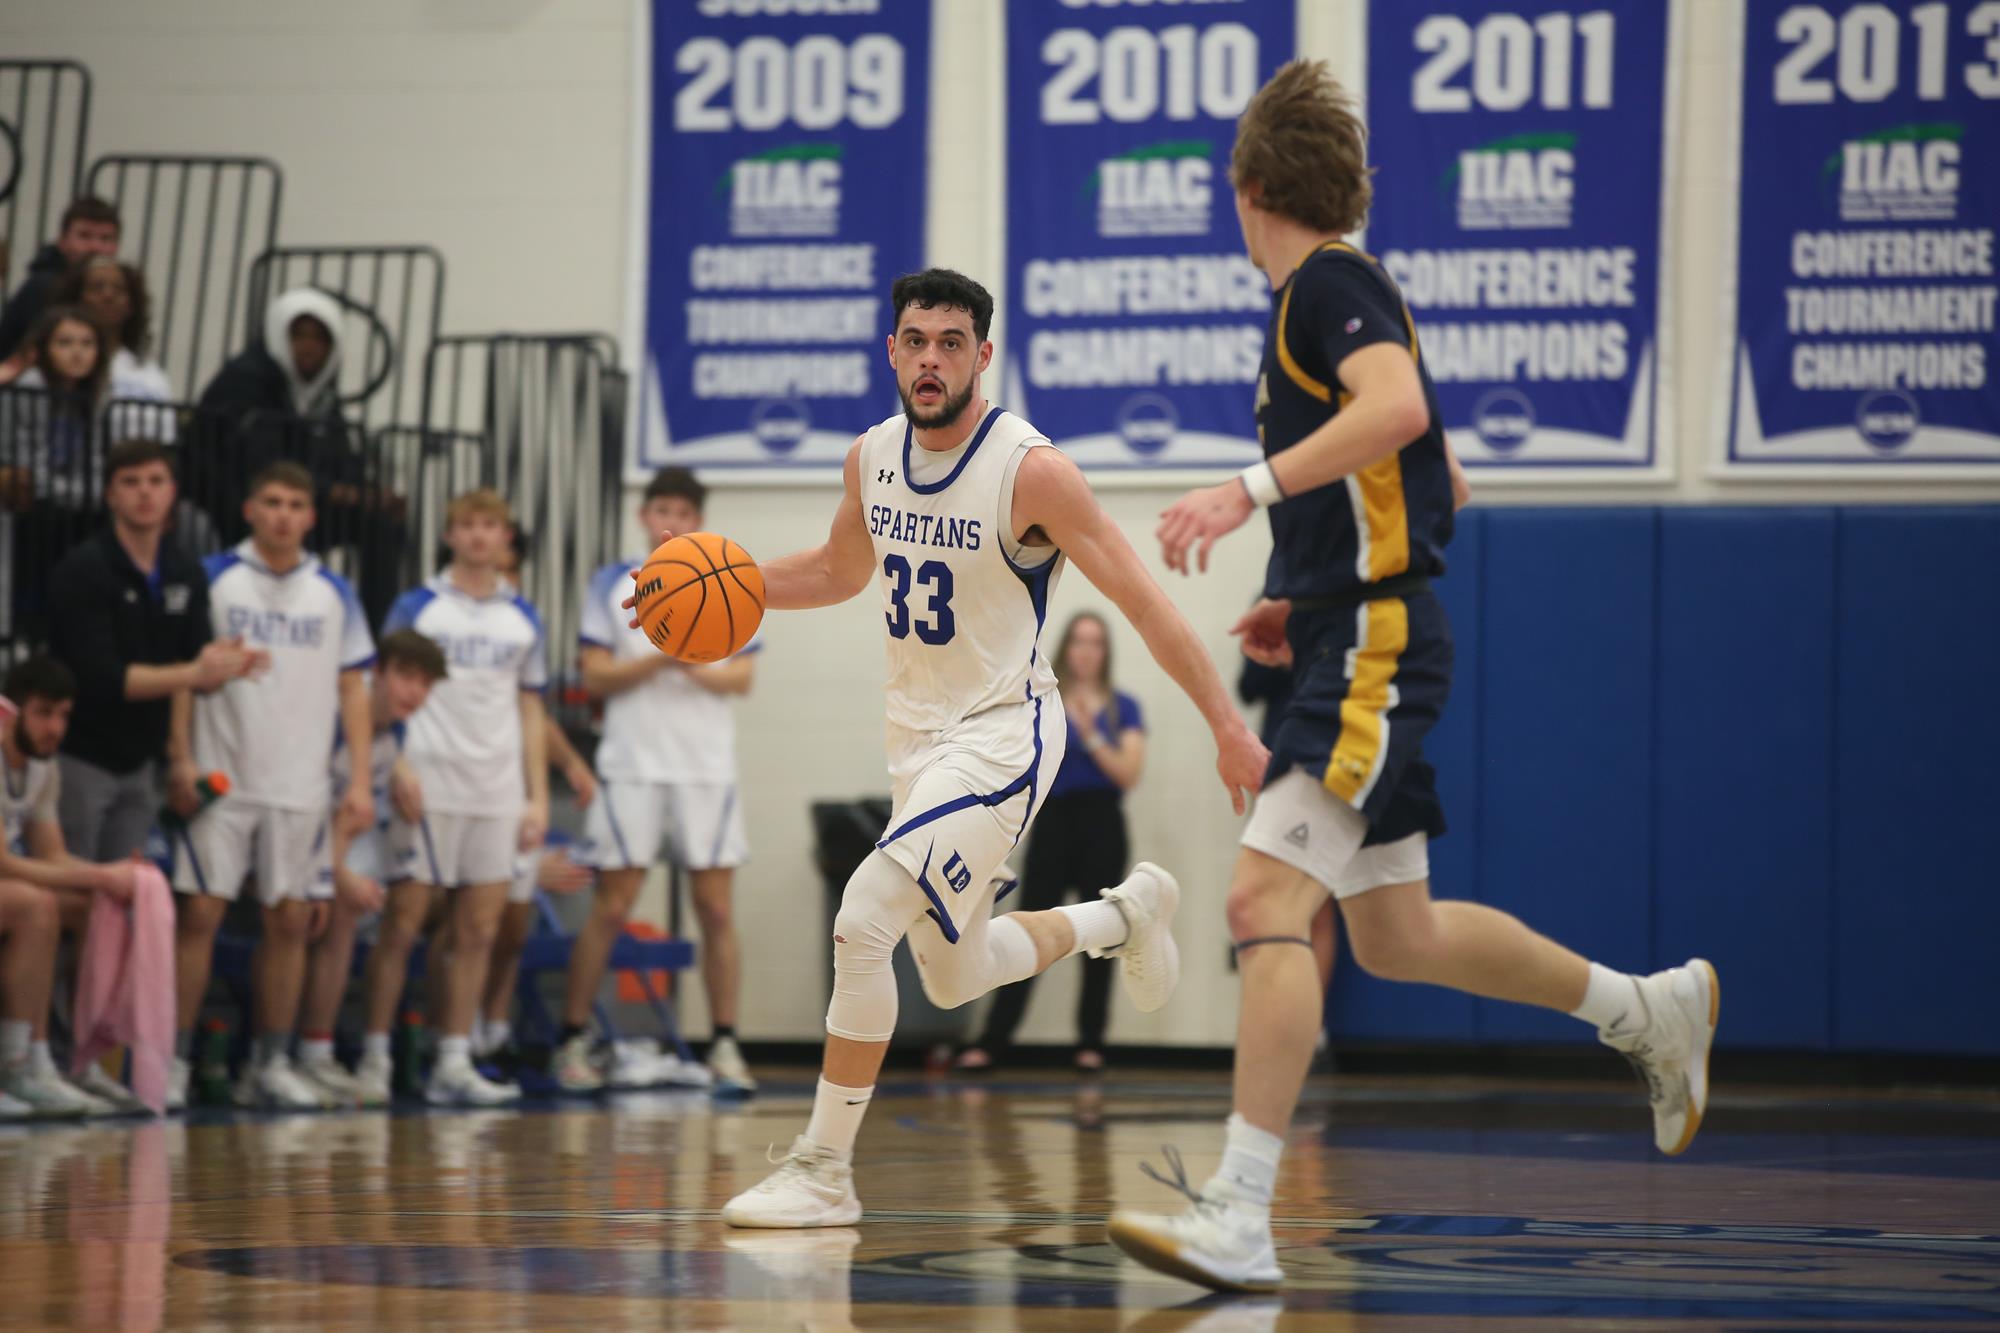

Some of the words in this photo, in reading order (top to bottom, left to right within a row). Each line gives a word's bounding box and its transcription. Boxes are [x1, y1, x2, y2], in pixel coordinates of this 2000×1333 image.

[674, 34, 906, 132] 2009
[1040, 22, 1260, 124] 2010
[1411, 11, 1615, 113] 2011
[1773, 2, 2000, 104] 2013
[690, 244, 876, 290] CONFERENCE
[1382, 247, 1637, 310] CONFERENCE
[1791, 229, 1993, 278] CONFERENCE
[1023, 253, 1271, 318] CONFERENCE
[1785, 286, 1998, 334] TOURNAMENT
[1028, 325, 1264, 388] CHAMPIONS
[1416, 320, 1629, 383] HAMPIONS
[1791, 342, 1987, 390] CHAMPIONS
[870, 504, 982, 551] SPARTANS
[883, 553, 956, 646] 33
